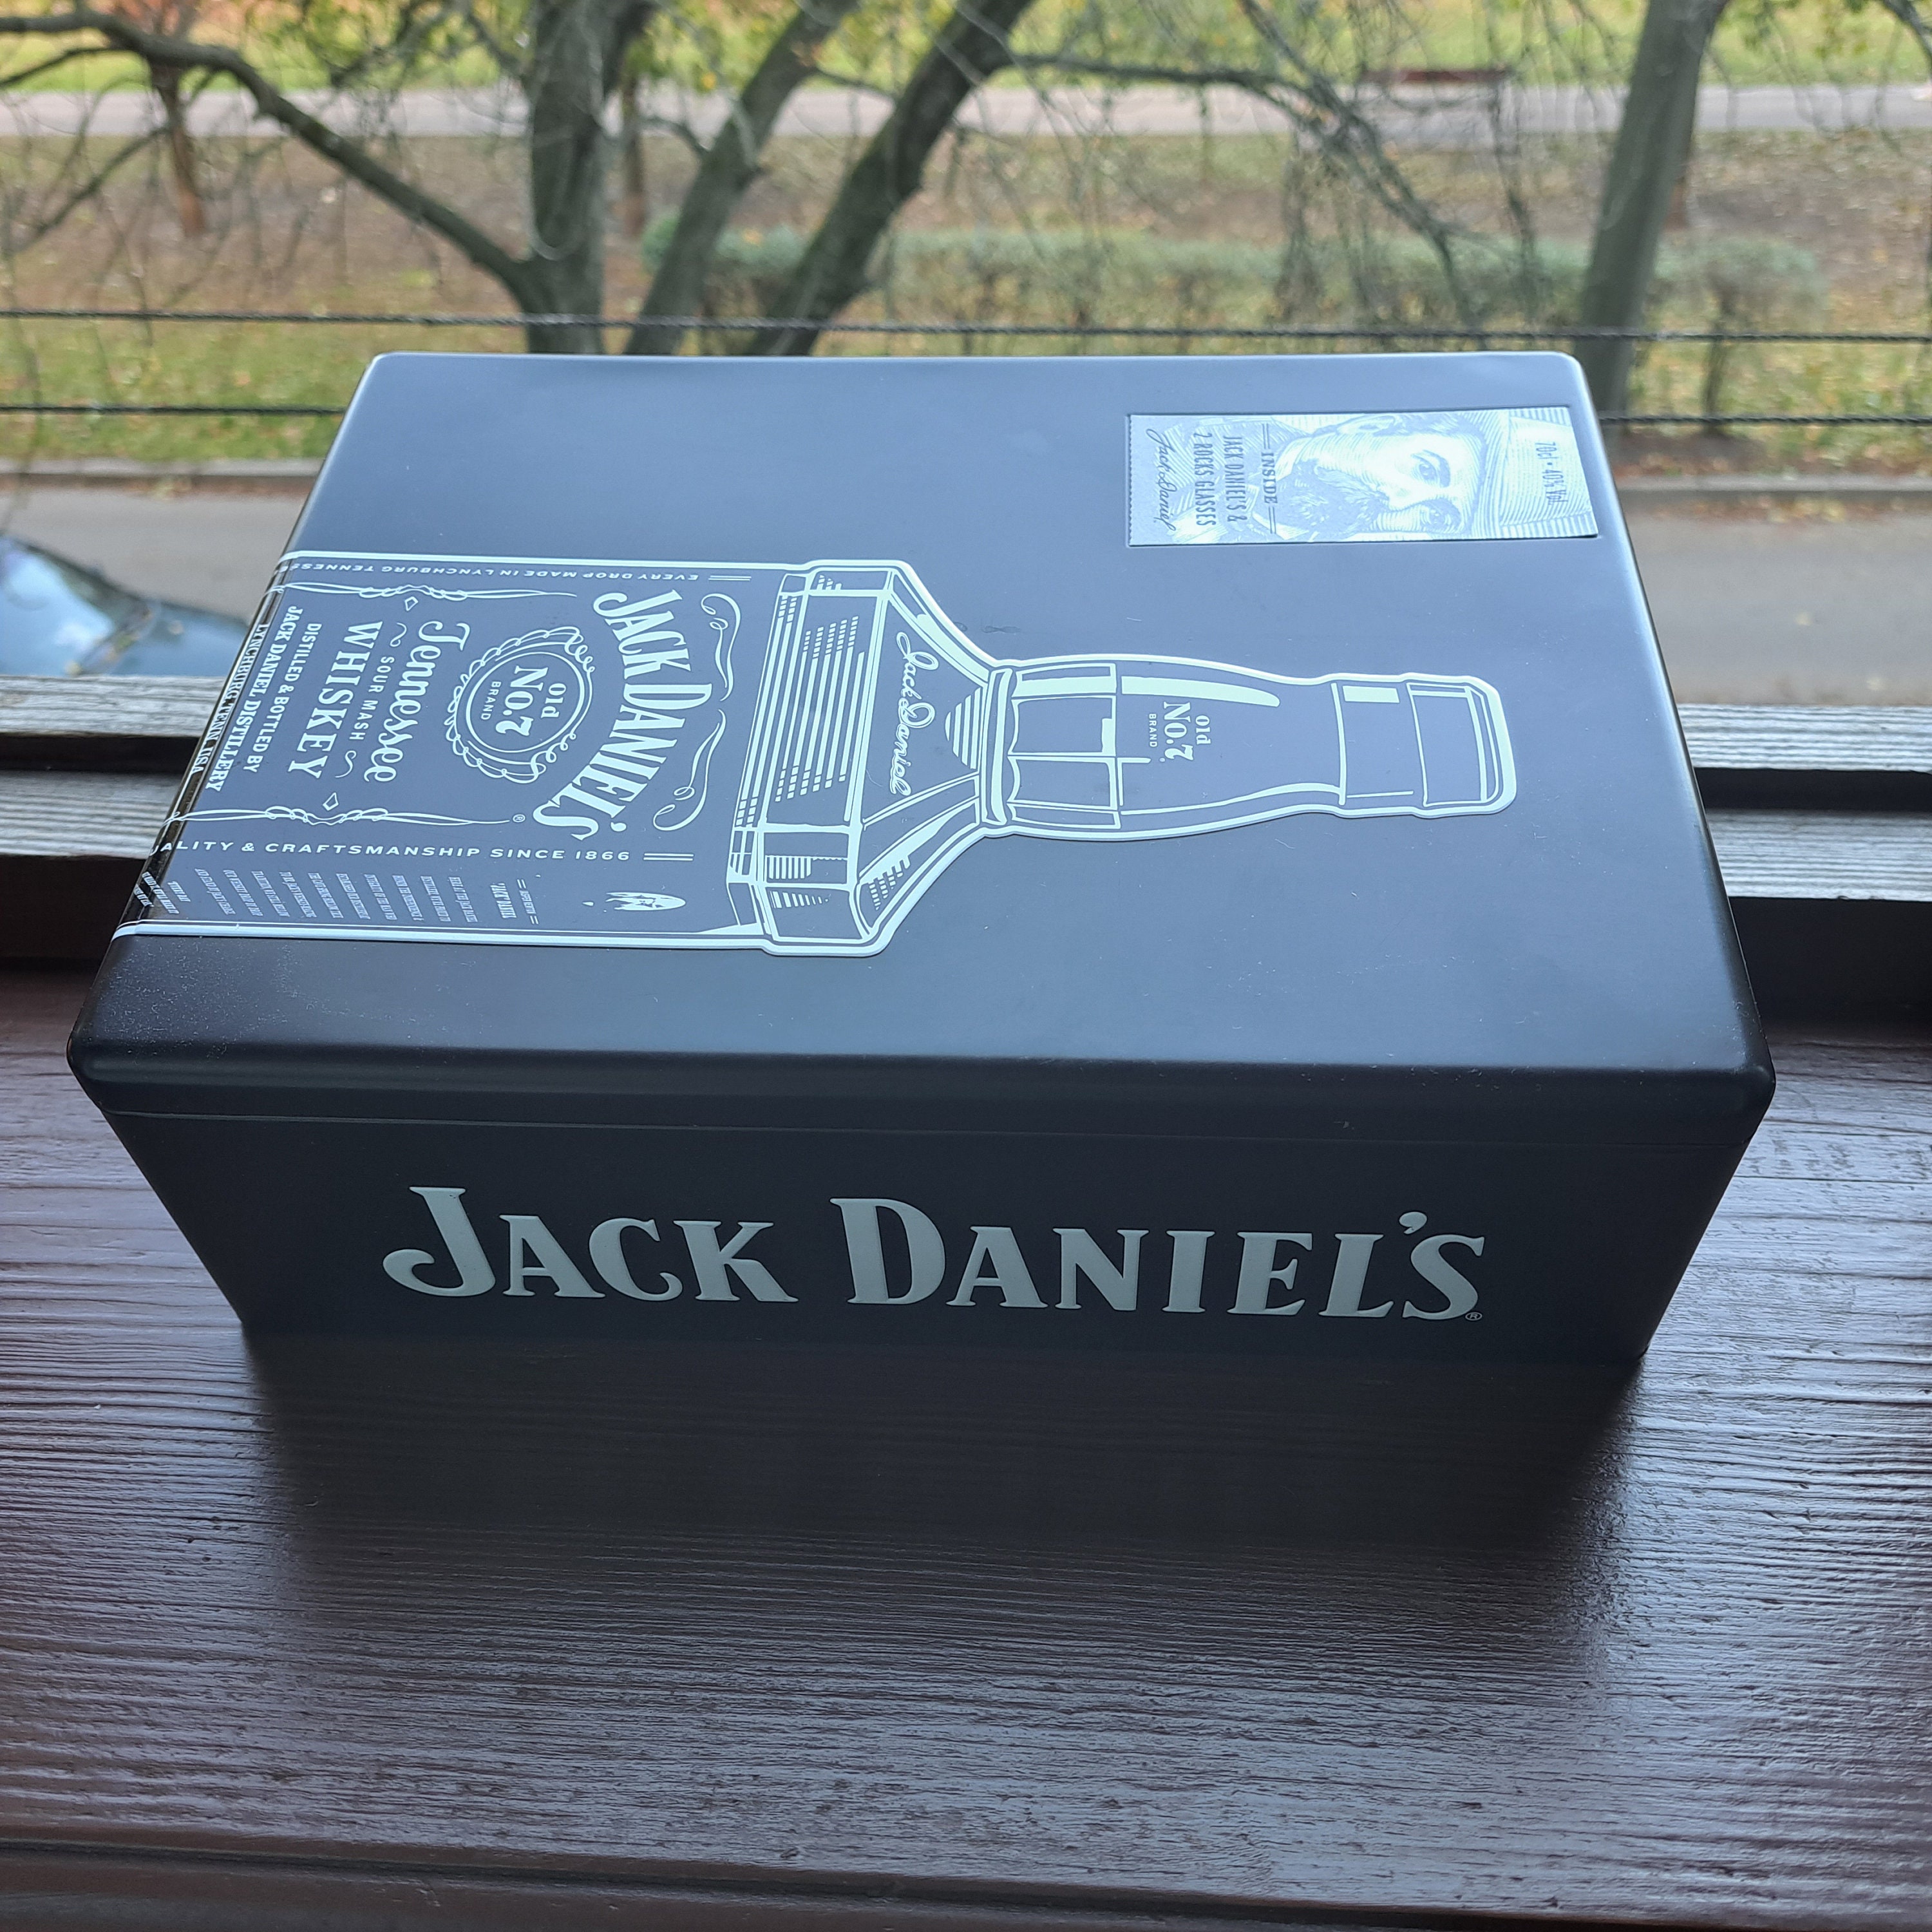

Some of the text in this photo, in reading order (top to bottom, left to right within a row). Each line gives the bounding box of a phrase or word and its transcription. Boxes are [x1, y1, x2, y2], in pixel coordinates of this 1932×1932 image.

[1193, 443, 1214, 476] ROCKS
[1223, 435, 1243, 459] JACK
[1535, 442, 1558, 459] 70cl
[1224, 464, 1246, 511] DANIEL'S
[1261, 452, 1278, 504] INSIDE
[1542, 469, 1564, 488] 40%
[1195, 480, 1217, 526] GLASSES
[381, 565, 494, 576] LYNCHBURG
[524, 569, 578, 578] MADE
[205, 605, 303, 791] JACK DANIEL DISTILLERY
[243, 623, 323, 773] DISTILLED & BOTTLED BY
[288, 621, 383, 779] WHISKEY
[349, 656, 395, 740] SOUR MASH
[364, 620, 470, 782] Tennessee
[480, 681, 501, 720] BRAND
[533, 589, 712, 840] JACK DANIEL'S
[1149, 713, 1158, 747] BRAND
[190, 746, 213, 775] USA
[241, 842, 256, 852] &
[265, 842, 480, 857] CRAFTSMANSHIP
[490, 848, 565, 859] SINCE
[575, 850, 630, 861] 1866
[383, 1186, 1486, 1320] JACK DANIEL'S
